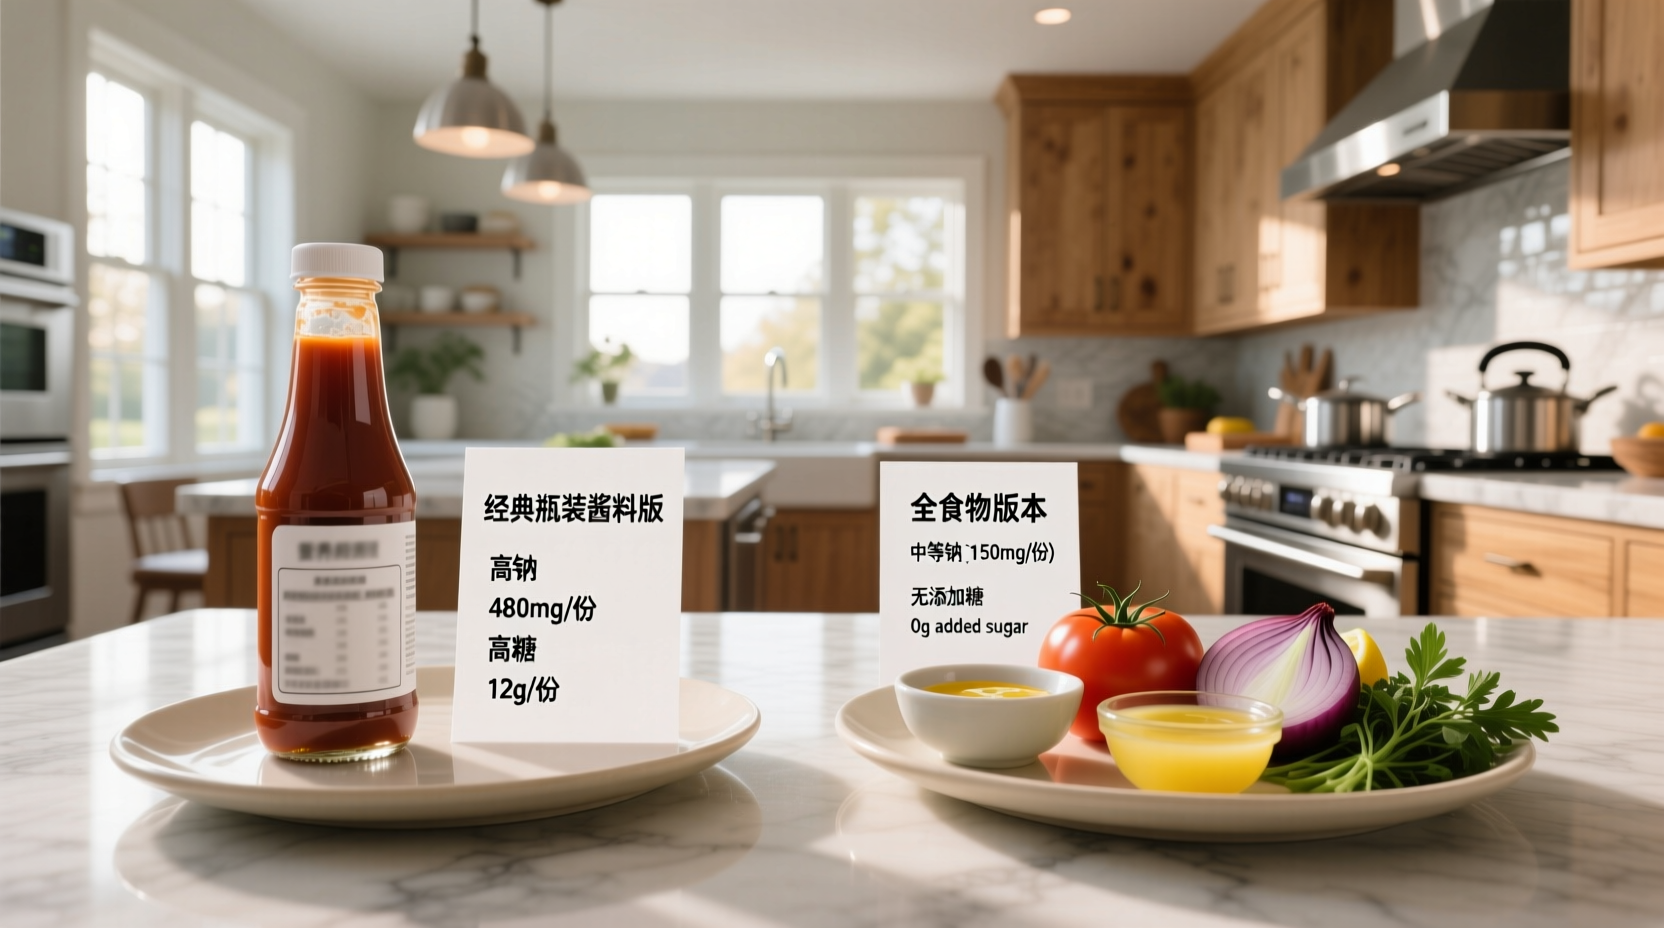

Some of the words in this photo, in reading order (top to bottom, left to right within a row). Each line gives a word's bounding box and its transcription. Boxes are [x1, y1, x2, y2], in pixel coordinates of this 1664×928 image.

[483, 493, 664, 524] 经典瓶装酱料版
[910, 492, 1048, 524] 全食物版本
[489, 553, 538, 583] 高钠
[488, 595, 597, 626] 480mg/份
[910, 585, 985, 607] 无添加糖
[910, 617, 930, 638] 0g
[935, 617, 982, 634] added
[985, 621, 1029, 638] sugar
[488, 634, 537, 663] 高糖
[488, 675, 560, 706] 12g/份
